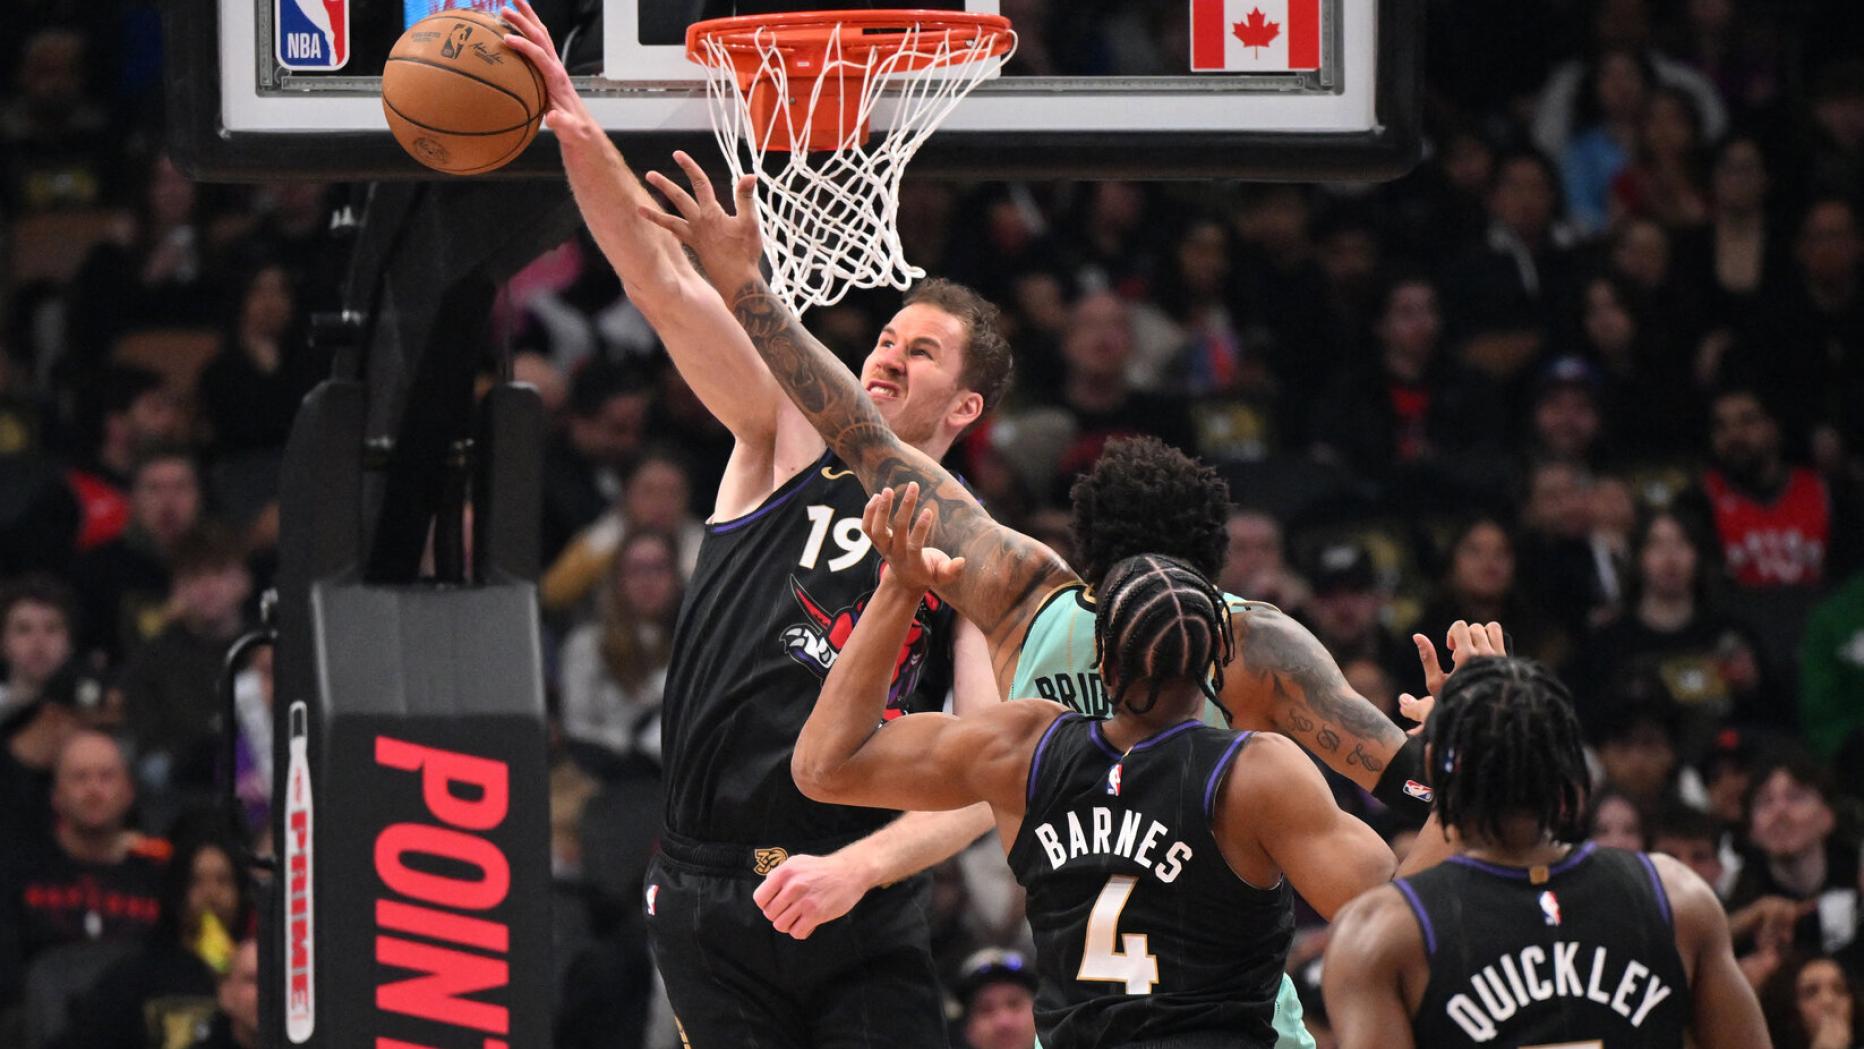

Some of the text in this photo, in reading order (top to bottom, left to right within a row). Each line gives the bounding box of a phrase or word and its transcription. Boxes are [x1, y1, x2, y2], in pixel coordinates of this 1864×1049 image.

[287, 32, 322, 59] NBA
[798, 504, 873, 573] 19
[1035, 671, 1109, 717] BRID
[1034, 806, 1193, 884] BARNES
[290, 810, 309, 1012] PRIME
[373, 734, 511, 1049] POIN
[1076, 873, 1160, 995] 4
[1446, 941, 1672, 1043] QUICKLEY
